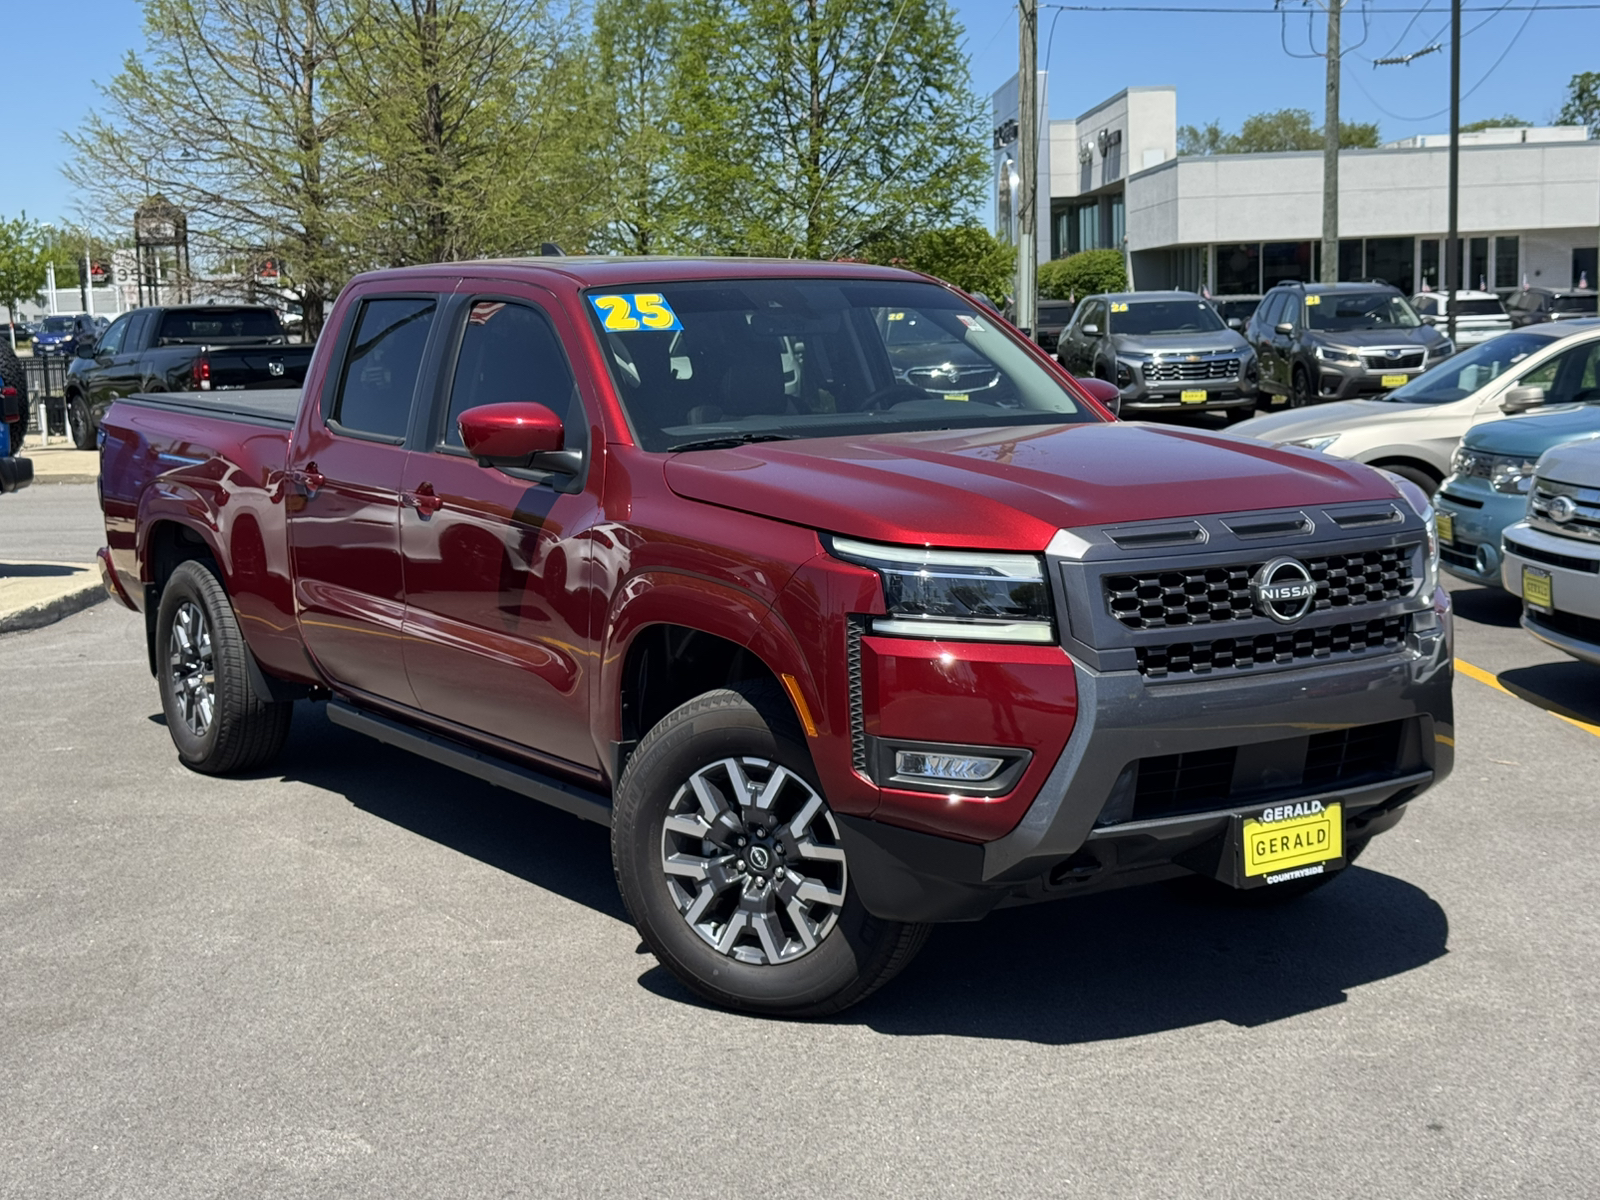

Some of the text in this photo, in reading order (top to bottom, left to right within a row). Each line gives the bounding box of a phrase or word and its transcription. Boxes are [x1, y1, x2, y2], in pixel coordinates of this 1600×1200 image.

[595, 293, 674, 331] 25
[1261, 583, 1318, 600] NISSAN
[1262, 800, 1322, 822] GERALD
[1256, 829, 1326, 856] GERALD
[1266, 865, 1325, 884] COUNTRYSIDE
